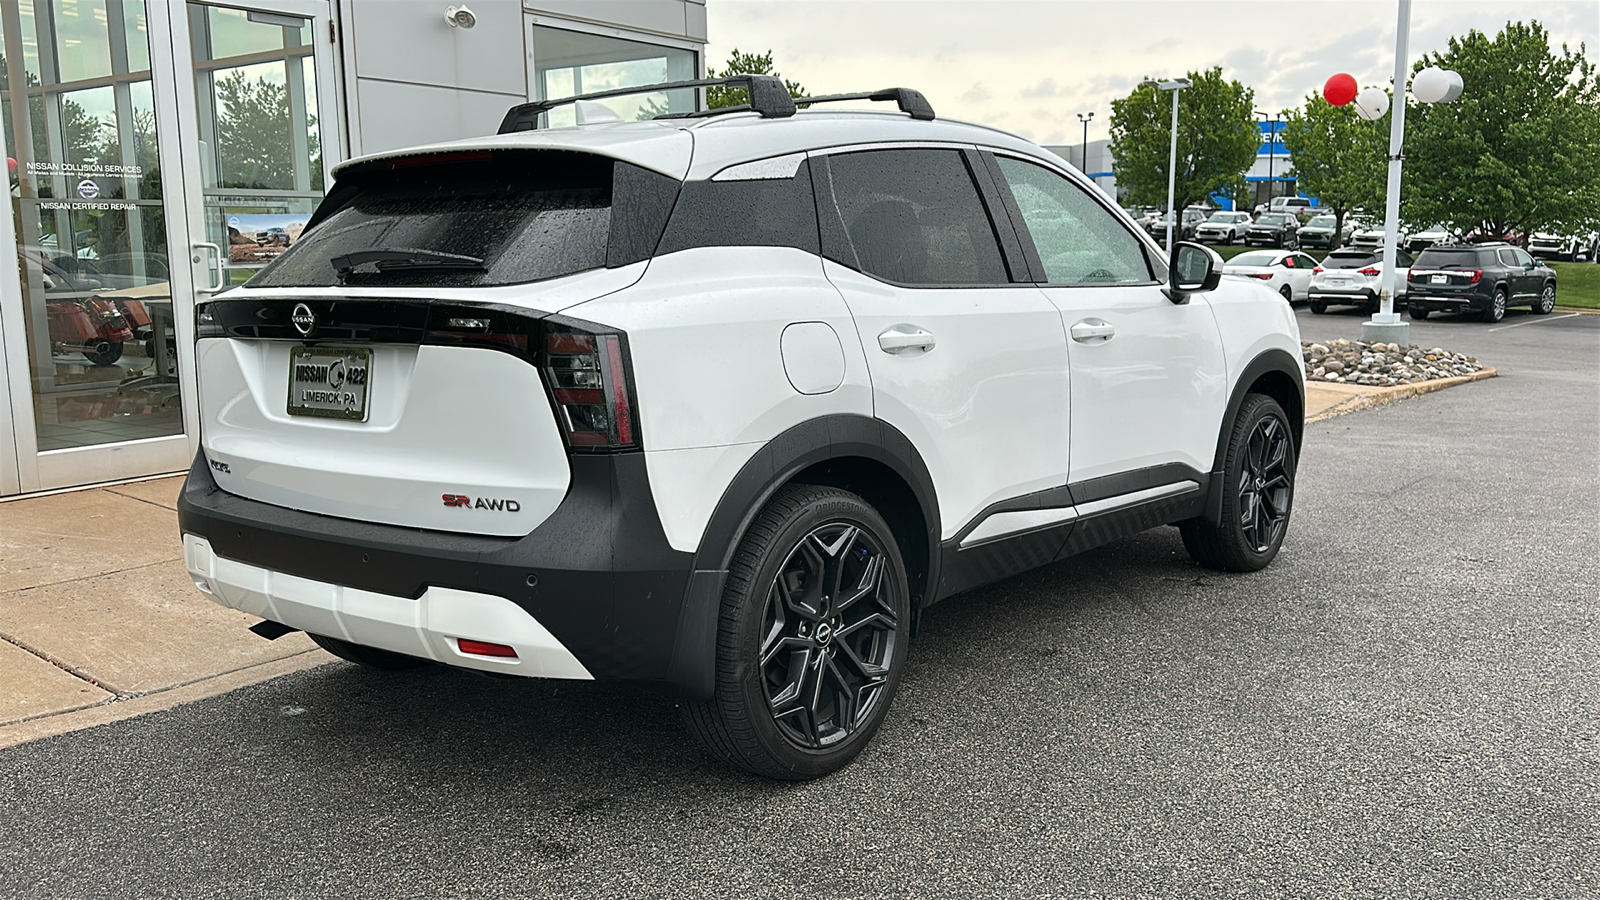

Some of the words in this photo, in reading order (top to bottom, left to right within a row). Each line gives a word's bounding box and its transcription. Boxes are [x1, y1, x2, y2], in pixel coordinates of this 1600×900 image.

[26, 162, 59, 170] NISSAN
[61, 163, 103, 172] COLLISION
[104, 165, 142, 173] SERVICES
[40, 202, 71, 210] NISSAN
[110, 203, 137, 211] REPAIR
[295, 365, 328, 383] NISSAN
[346, 367, 365, 385] 422
[301, 390, 342, 405] LIMERICK,
[344, 393, 356, 405] PA
[442, 494, 472, 509] SR
[475, 497, 521, 512] AWD
[815, 501, 868, 515] BRIDGESTONE
